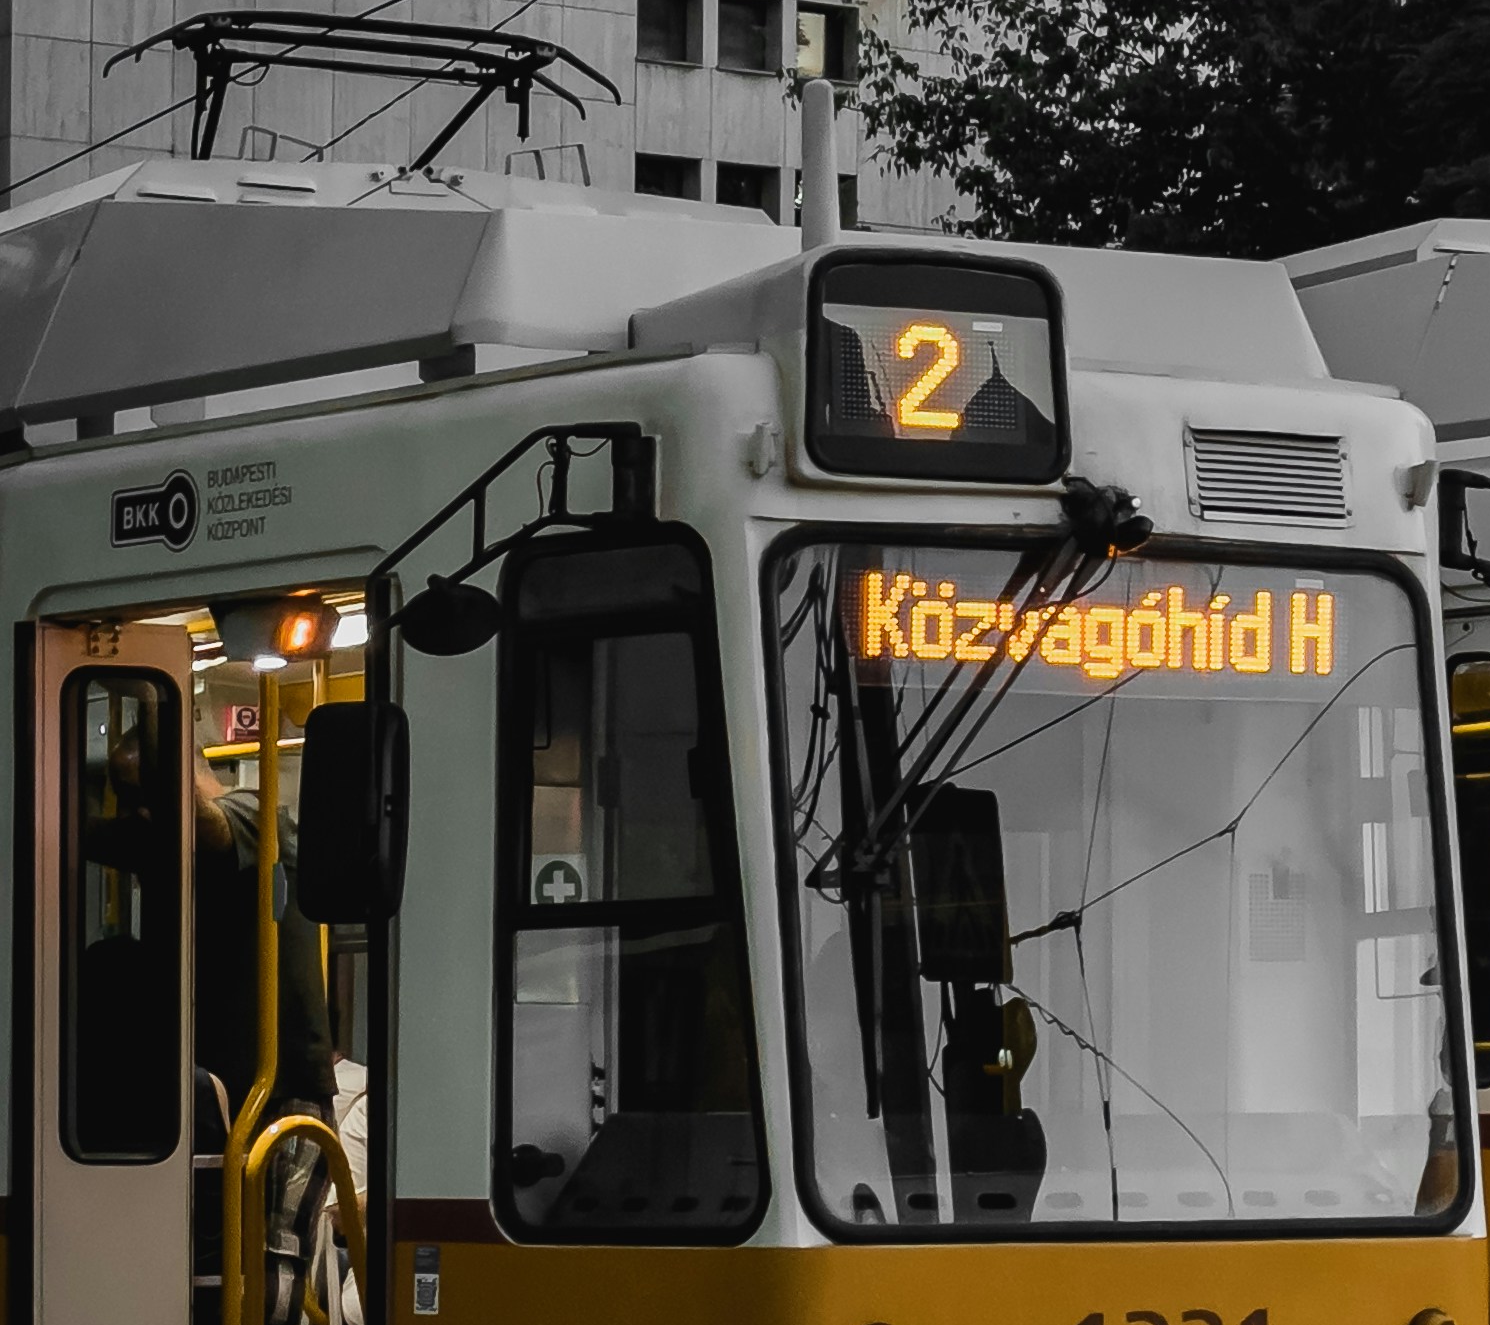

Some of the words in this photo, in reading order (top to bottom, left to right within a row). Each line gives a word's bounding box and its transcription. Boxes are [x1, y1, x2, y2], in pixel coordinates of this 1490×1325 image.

[898, 324, 960, 429] 2
[207, 461, 276, 488] BUDAPESTI
[207, 483, 292, 515] KÖZLEKEDÉSI
[123, 502, 160, 530] BKK
[207, 516, 266, 541] KÖZPONT
[865, 572, 1273, 679] Közvagóhíd
[1289, 591, 1335, 676] H
